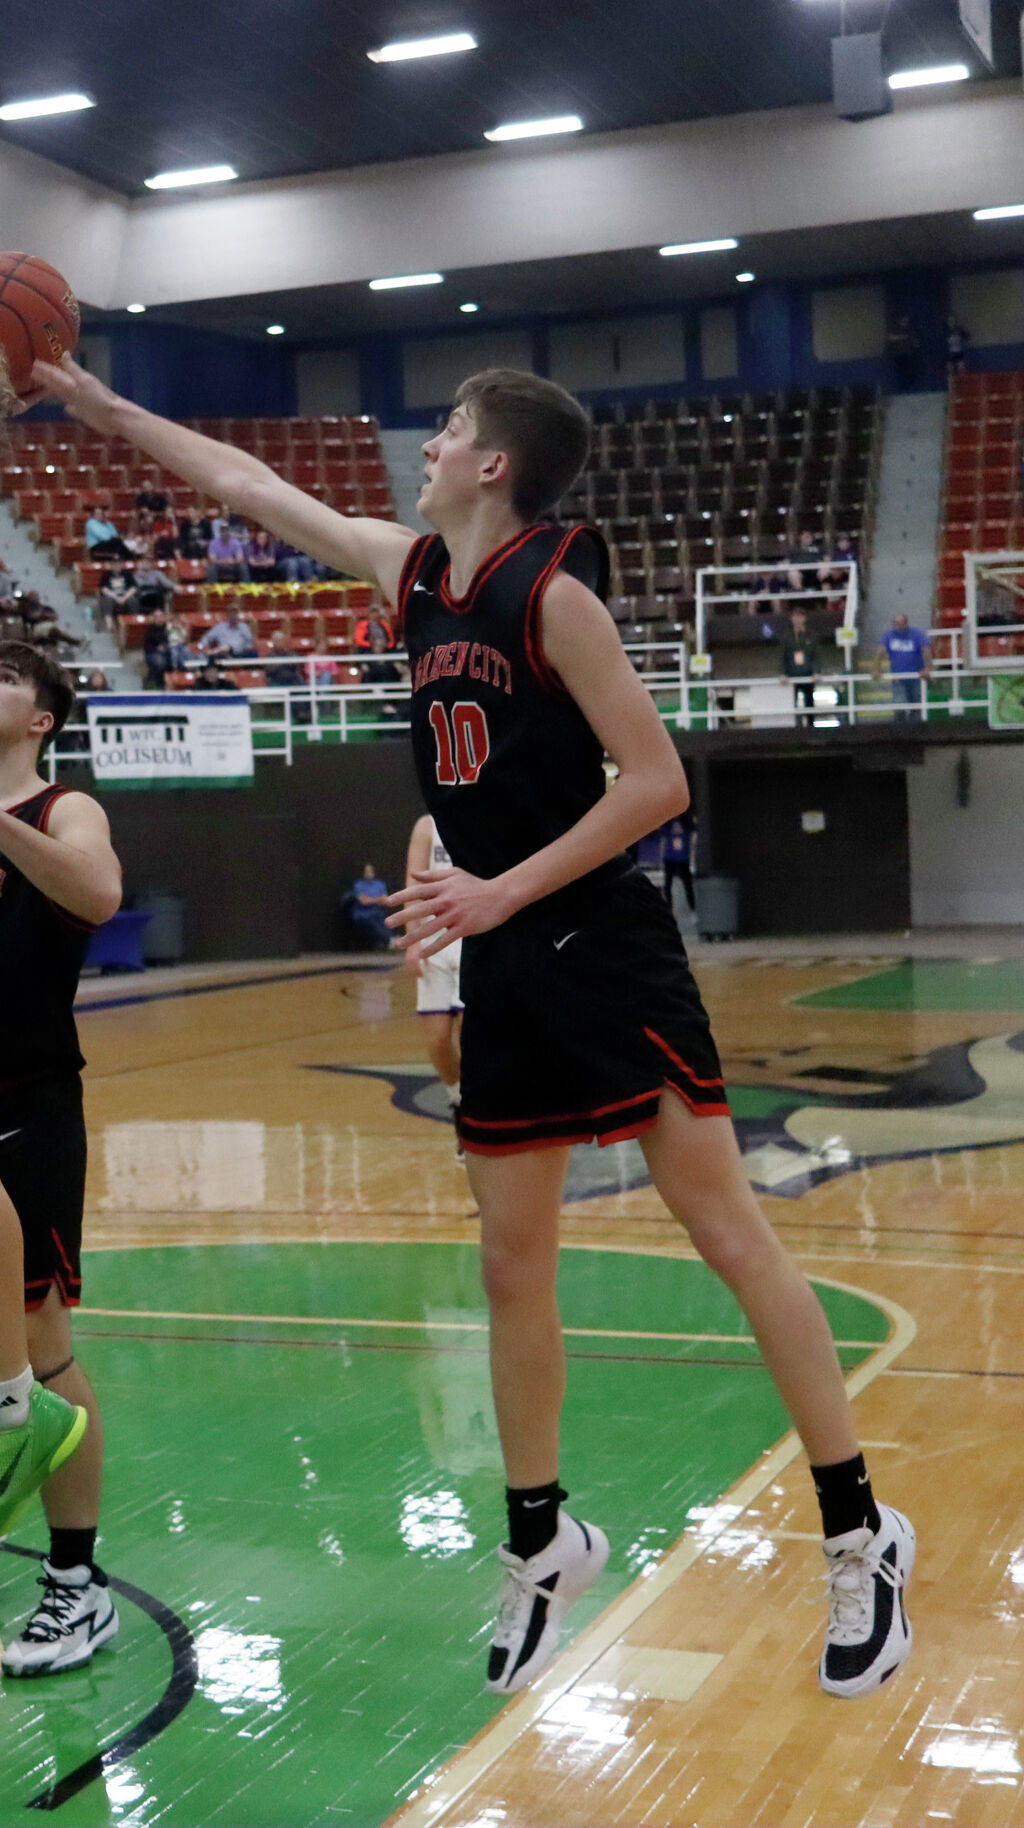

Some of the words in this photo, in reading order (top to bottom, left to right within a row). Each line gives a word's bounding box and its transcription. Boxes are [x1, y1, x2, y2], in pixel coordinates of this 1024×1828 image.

[469, 642, 512, 695] CITY
[95, 748, 192, 768] COLISEUM
[429, 701, 490, 785] 10
